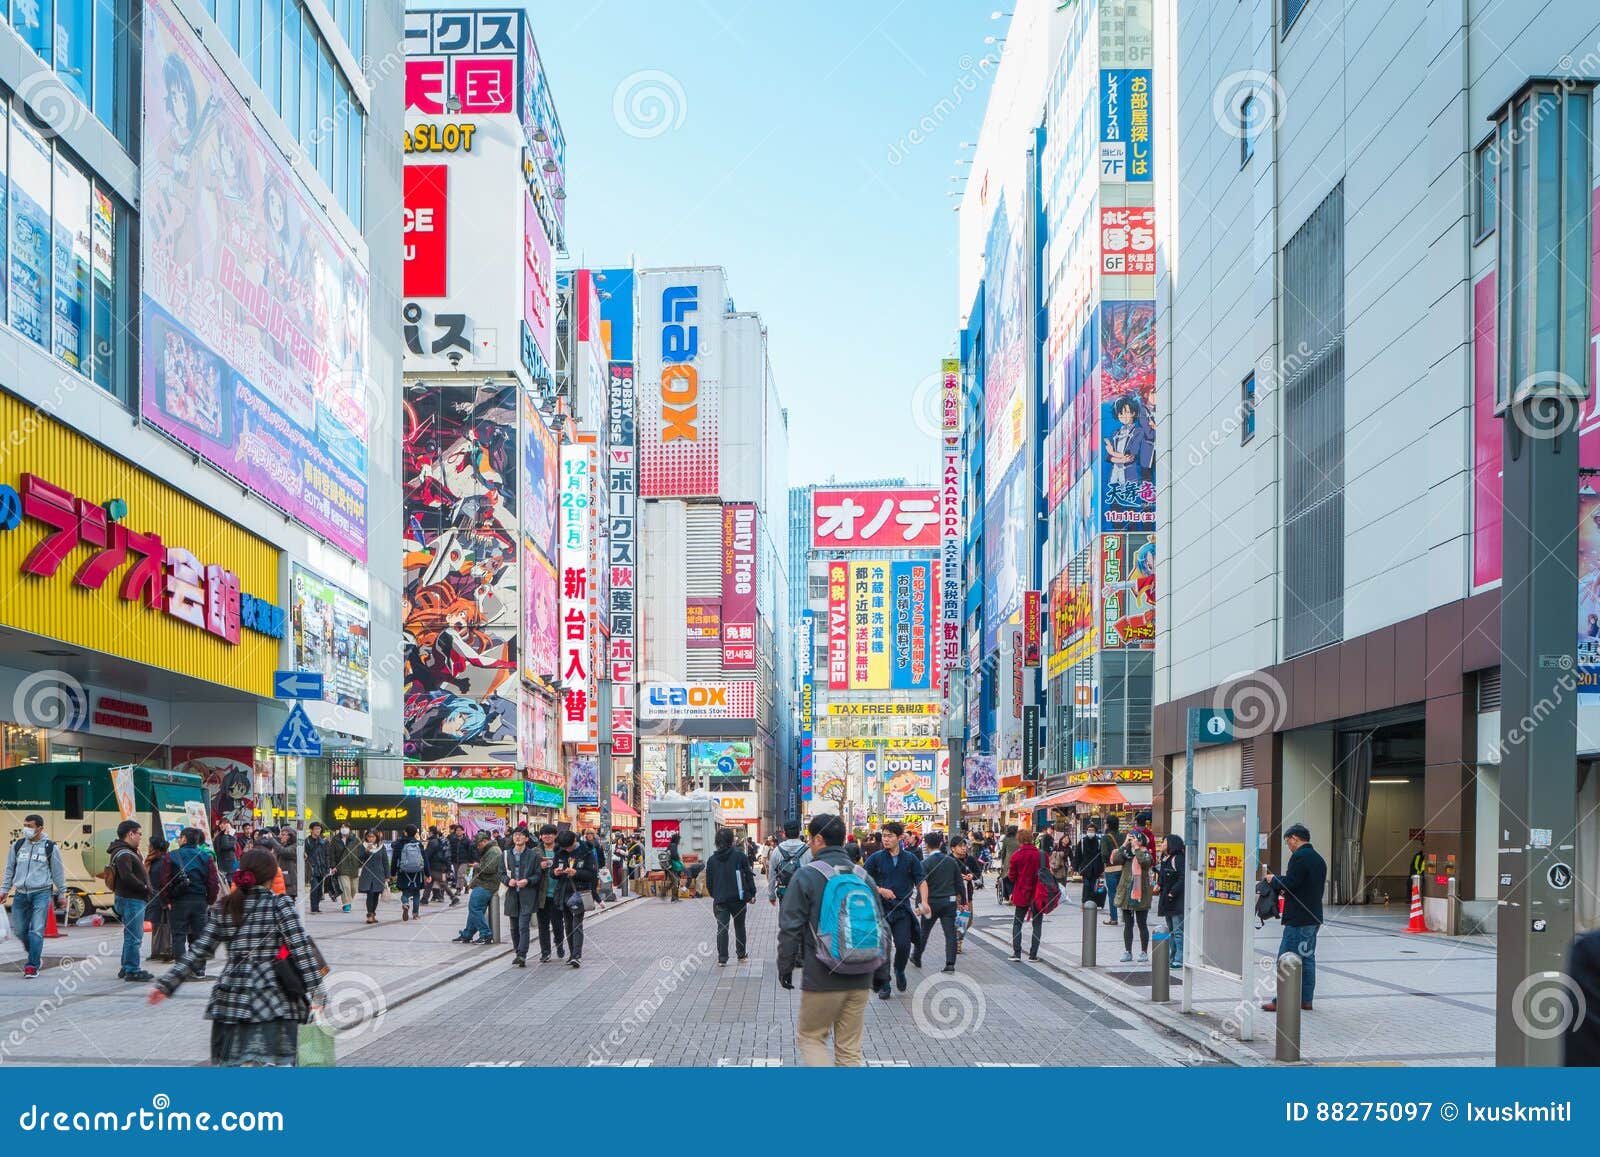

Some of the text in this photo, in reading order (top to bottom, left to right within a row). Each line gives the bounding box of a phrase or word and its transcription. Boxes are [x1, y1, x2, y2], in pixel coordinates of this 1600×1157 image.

[1128, 46, 1151, 61] 8F
[1131, 76, 1148, 175] お部屋探しは
[1101, 148, 1124, 157] 当ビル
[1101, 159, 1124, 175] 7F
[1103, 225, 1154, 251] ぽち
[1127, 253, 1154, 262] 秋葉原
[1105, 257, 1123, 270] 6F
[1127, 263, 1154, 272] 2号店
[610, 366, 622, 444] PARADISE
[621, 366, 634, 418] HOBBY
[944, 455, 958, 536] TAKARADA
[725, 509, 734, 575] Flagship Store
[733, 509, 755, 595] Duty Free
[944, 580, 959, 620] 免税商店
[1104, 535, 1121, 647] カードゲム専門店
[726, 626, 753, 639] 免税
[831, 602, 846, 637] TAX
[855, 566, 869, 682] 都内・近郊送料無料
[897, 575, 910, 668] お見積り無料です
[912, 566, 926, 684] 防犯カメラ販売開始!!
[564, 566, 587, 722] 新台入替
[831, 639, 846, 683] FREE
[648, 707, 727, 715] Home Electronics Store
[803, 683, 813, 732] ONODEN
[833, 704, 859, 714] TAX
[861, 704, 893, 714] FREE
[895, 704, 924, 714] 免税店
[834, 739, 859, 748] テレビ
[893, 739, 928, 748] エアコン
[473, 786, 514, 799] 256ver
